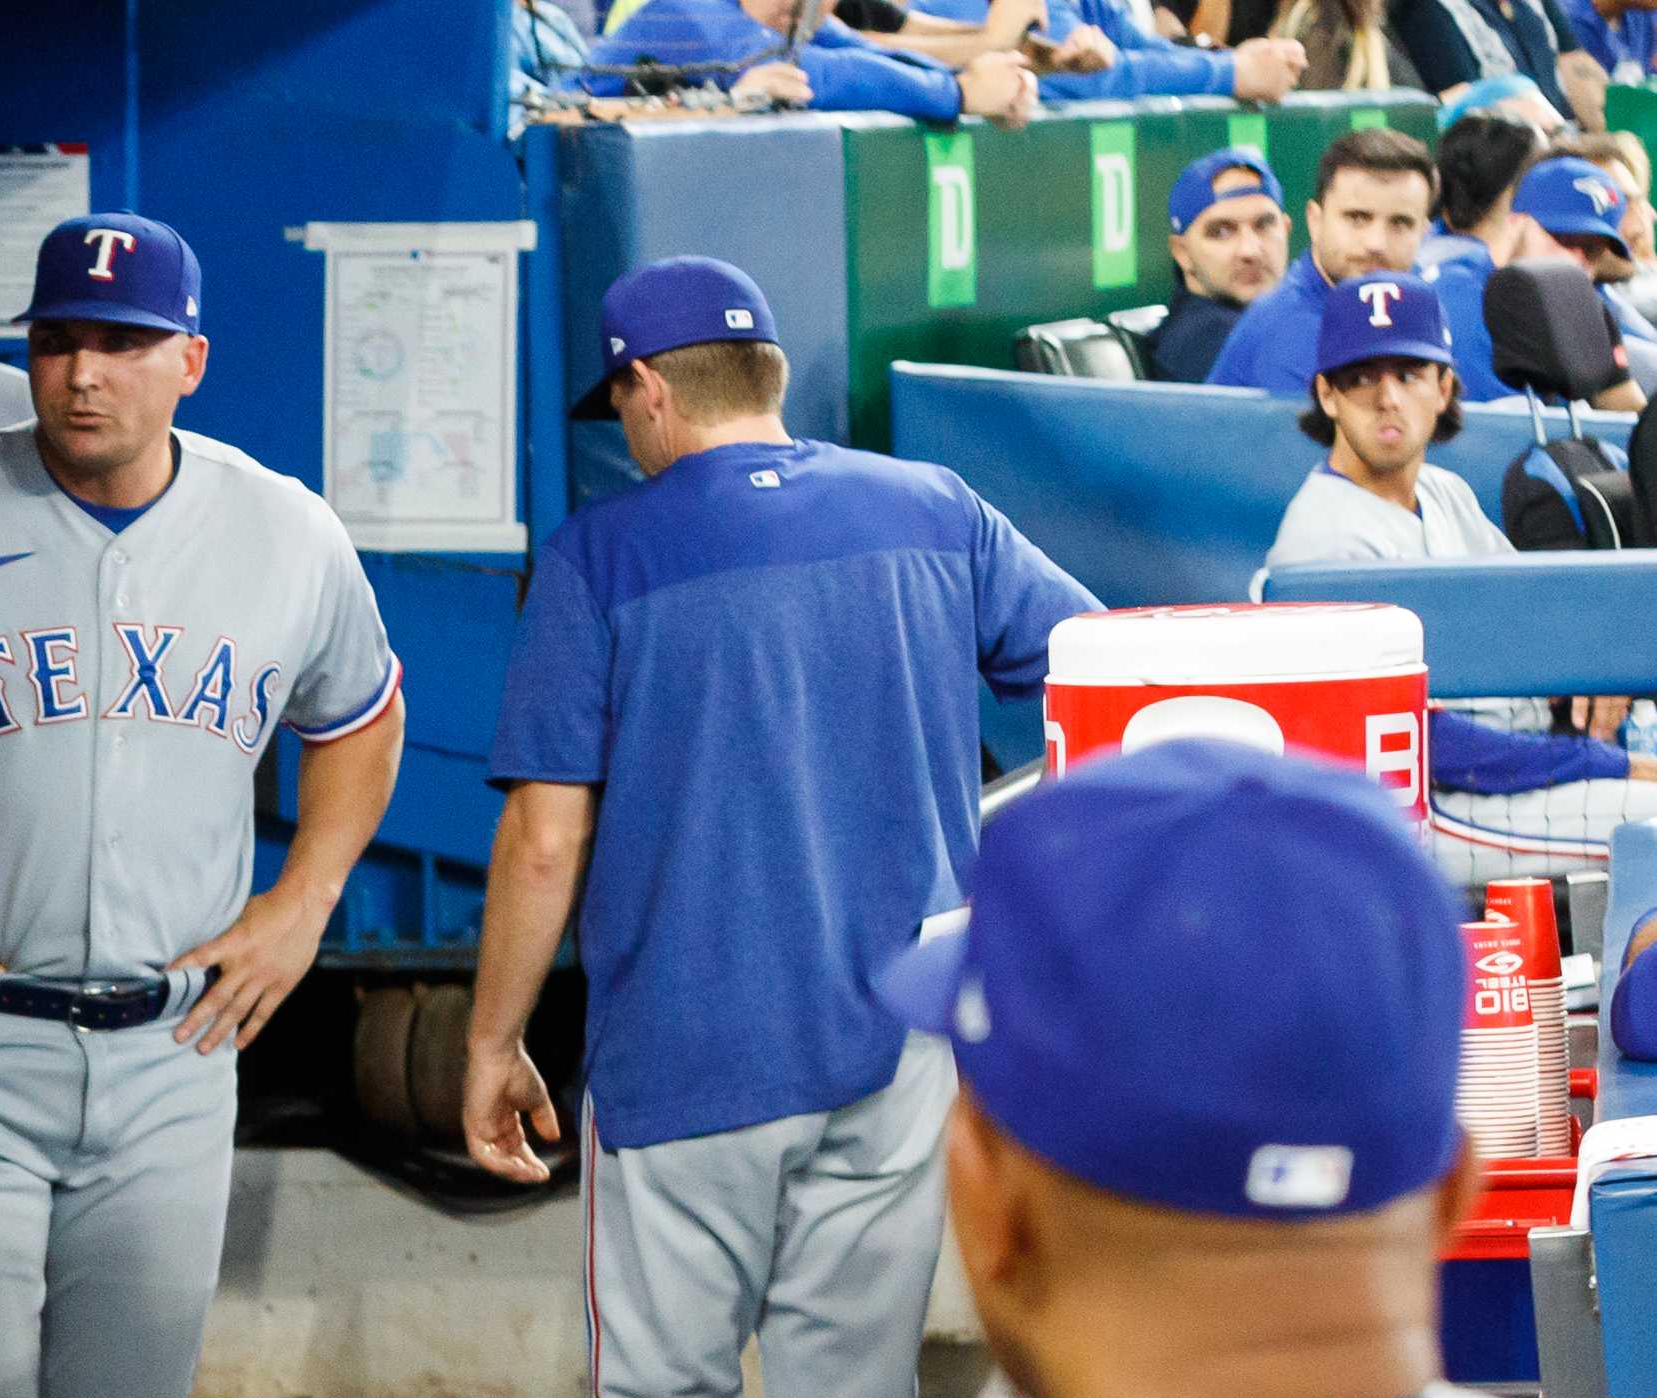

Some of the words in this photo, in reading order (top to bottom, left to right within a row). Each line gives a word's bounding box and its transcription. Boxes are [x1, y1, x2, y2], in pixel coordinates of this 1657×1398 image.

[85, 228, 136, 282] T
[1358, 281, 1404, 328] T
[1474, 987, 1530, 1015] BIO
